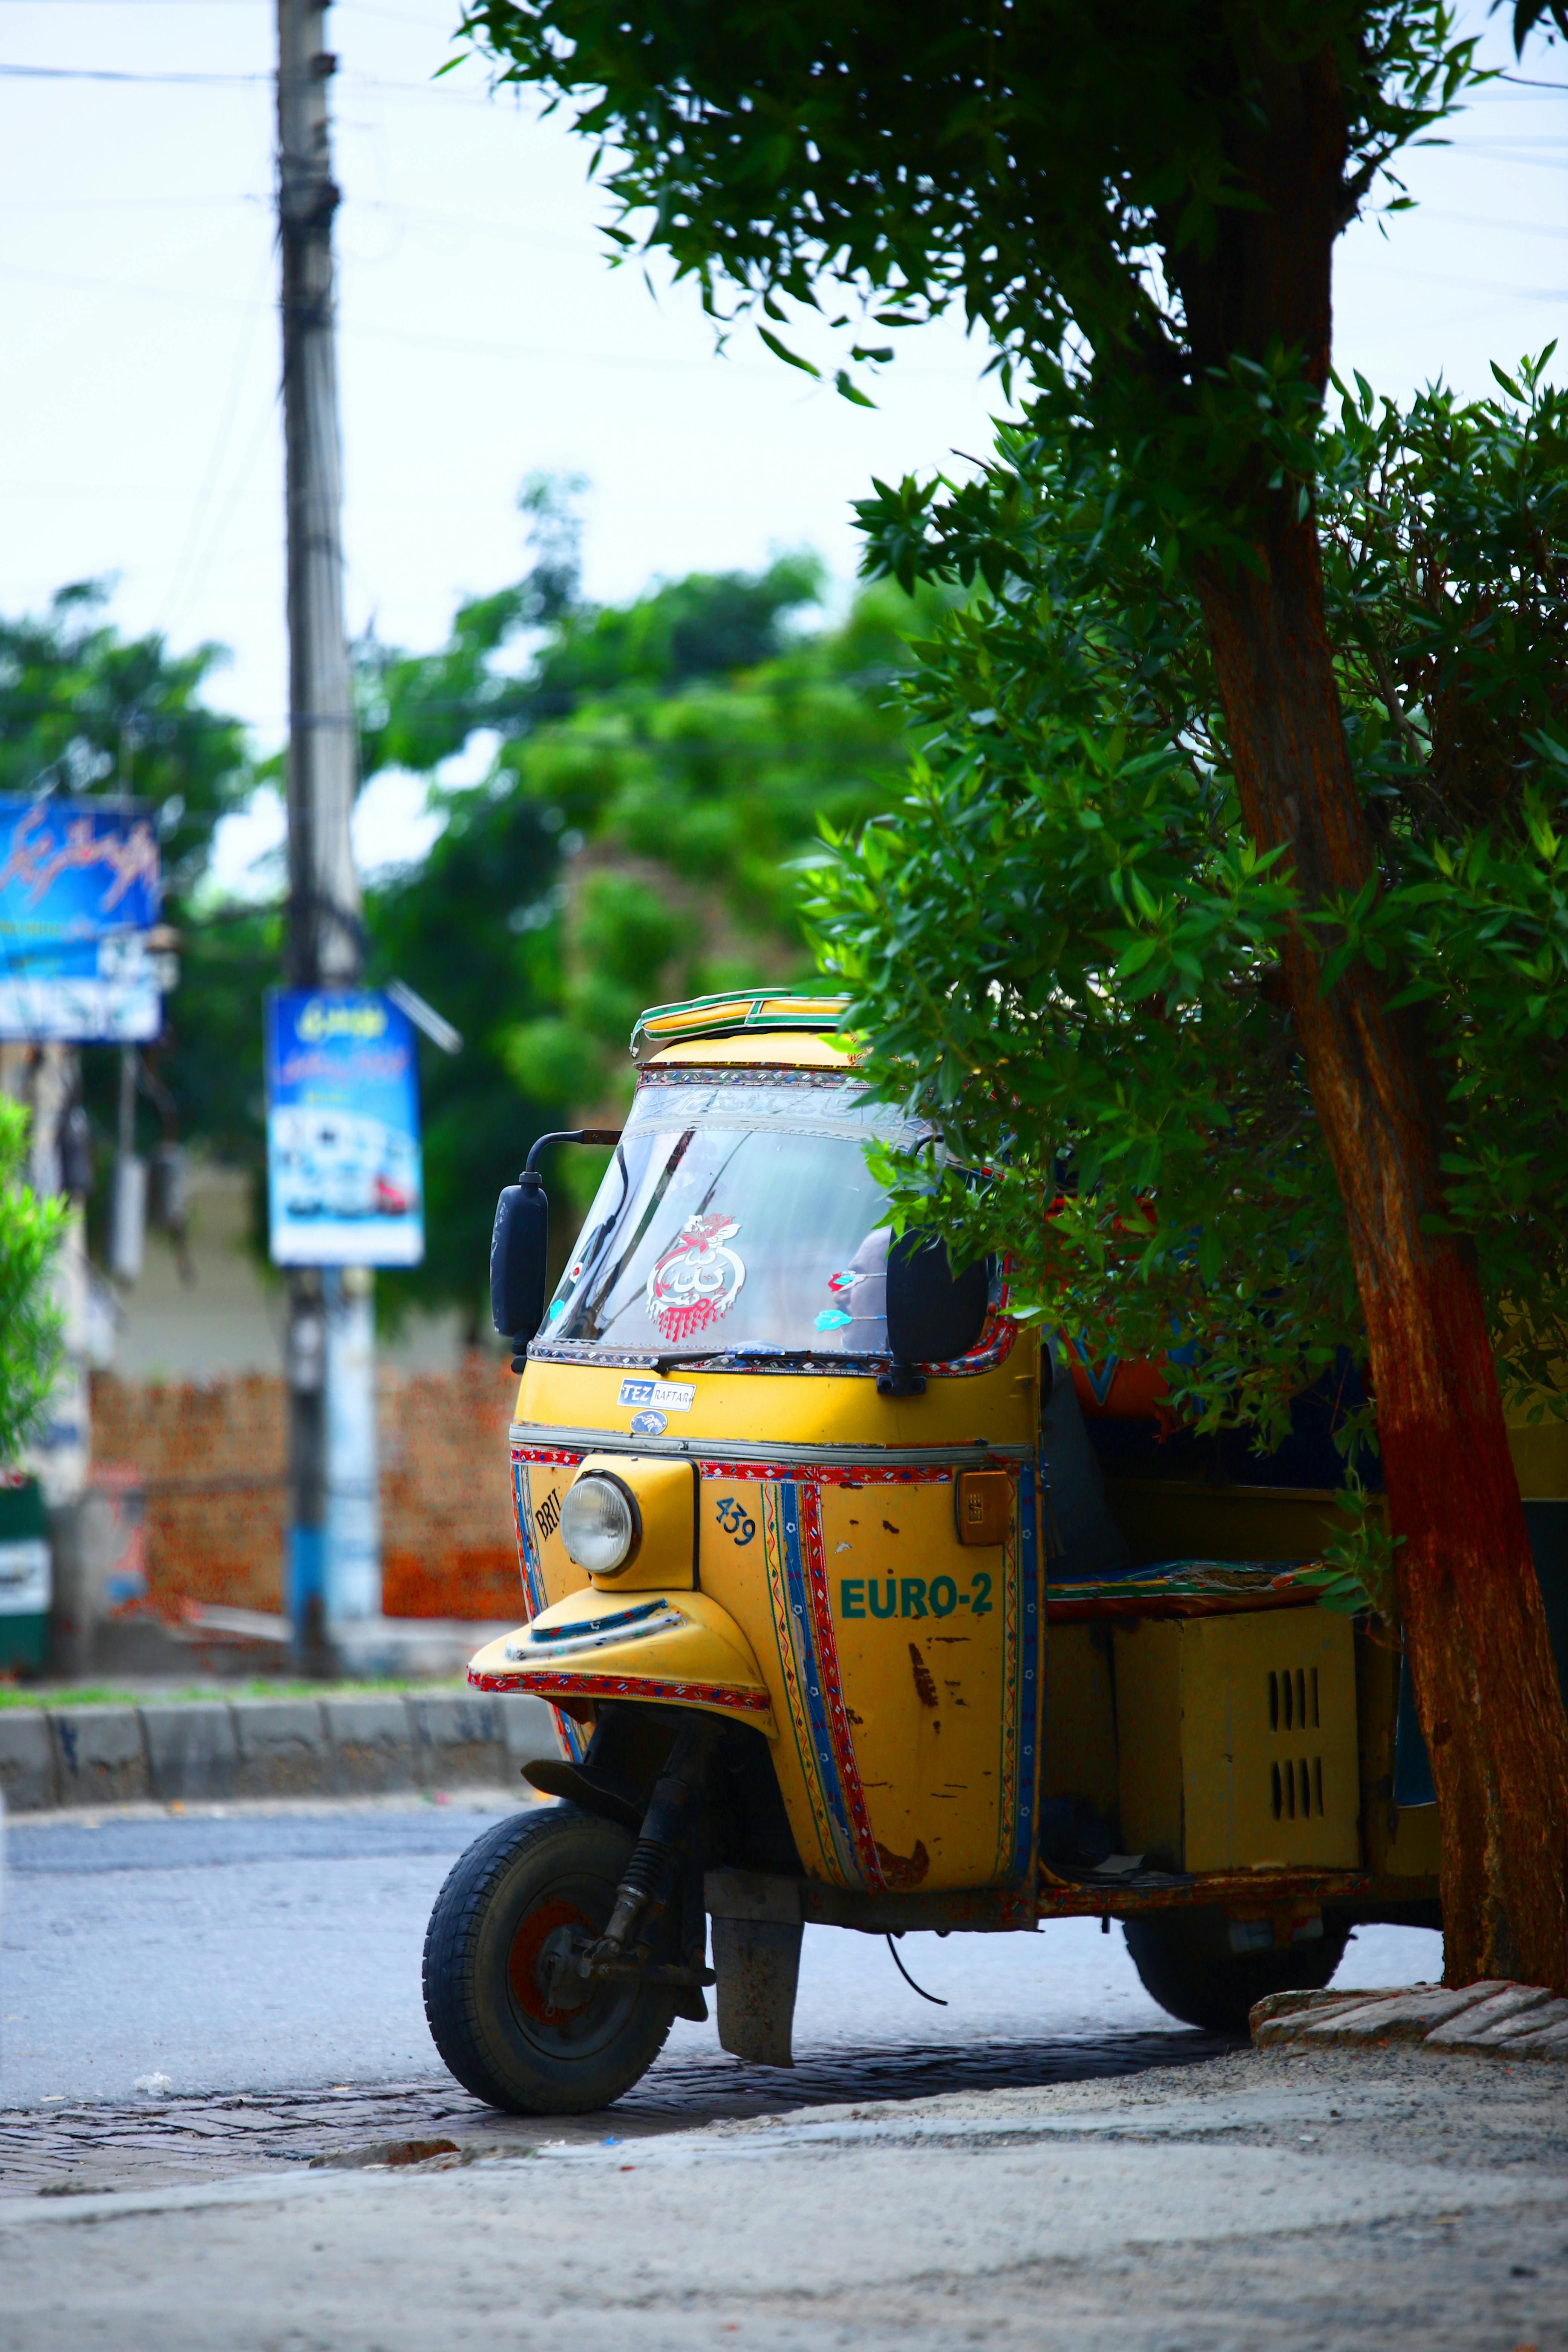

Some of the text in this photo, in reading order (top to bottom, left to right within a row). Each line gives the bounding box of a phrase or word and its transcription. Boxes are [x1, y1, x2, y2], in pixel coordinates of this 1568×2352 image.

[623, 1384, 689, 1403] TEZ RAFTAR
[716, 1497, 756, 1546] 439
[841, 1573, 992, 1619] EURO-2
